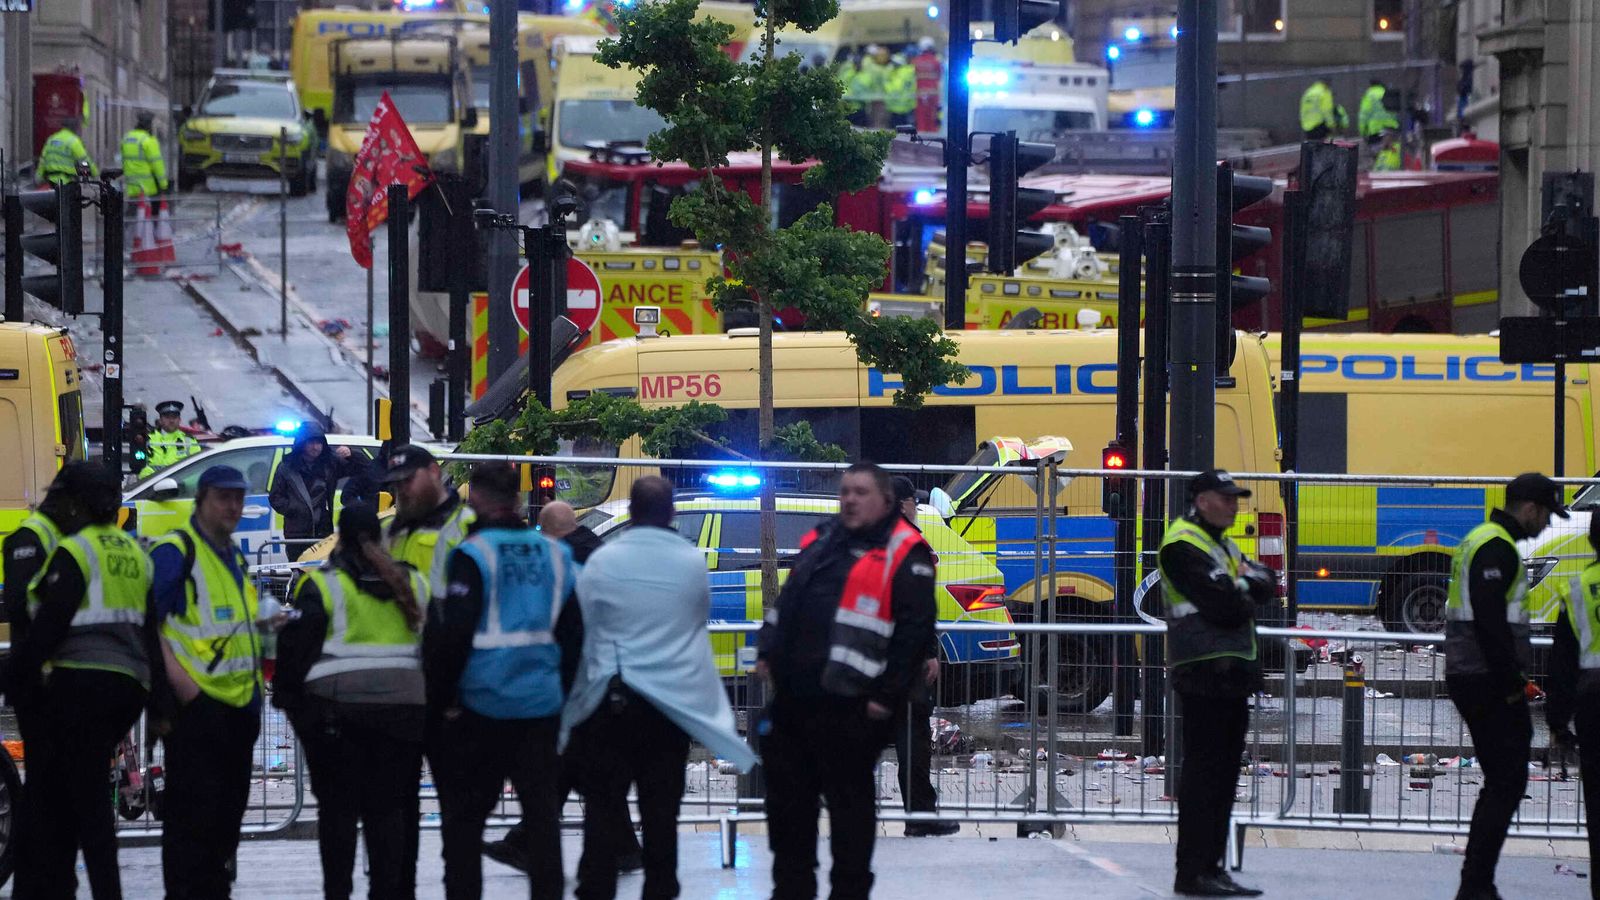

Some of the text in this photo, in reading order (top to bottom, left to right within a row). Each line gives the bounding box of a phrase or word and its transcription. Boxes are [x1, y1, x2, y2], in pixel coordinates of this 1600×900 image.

[603, 283, 684, 304] ANCE
[868, 363, 1118, 397] POLIC
[1299, 354, 1567, 382] POLICE
[641, 373, 722, 399] MP56
